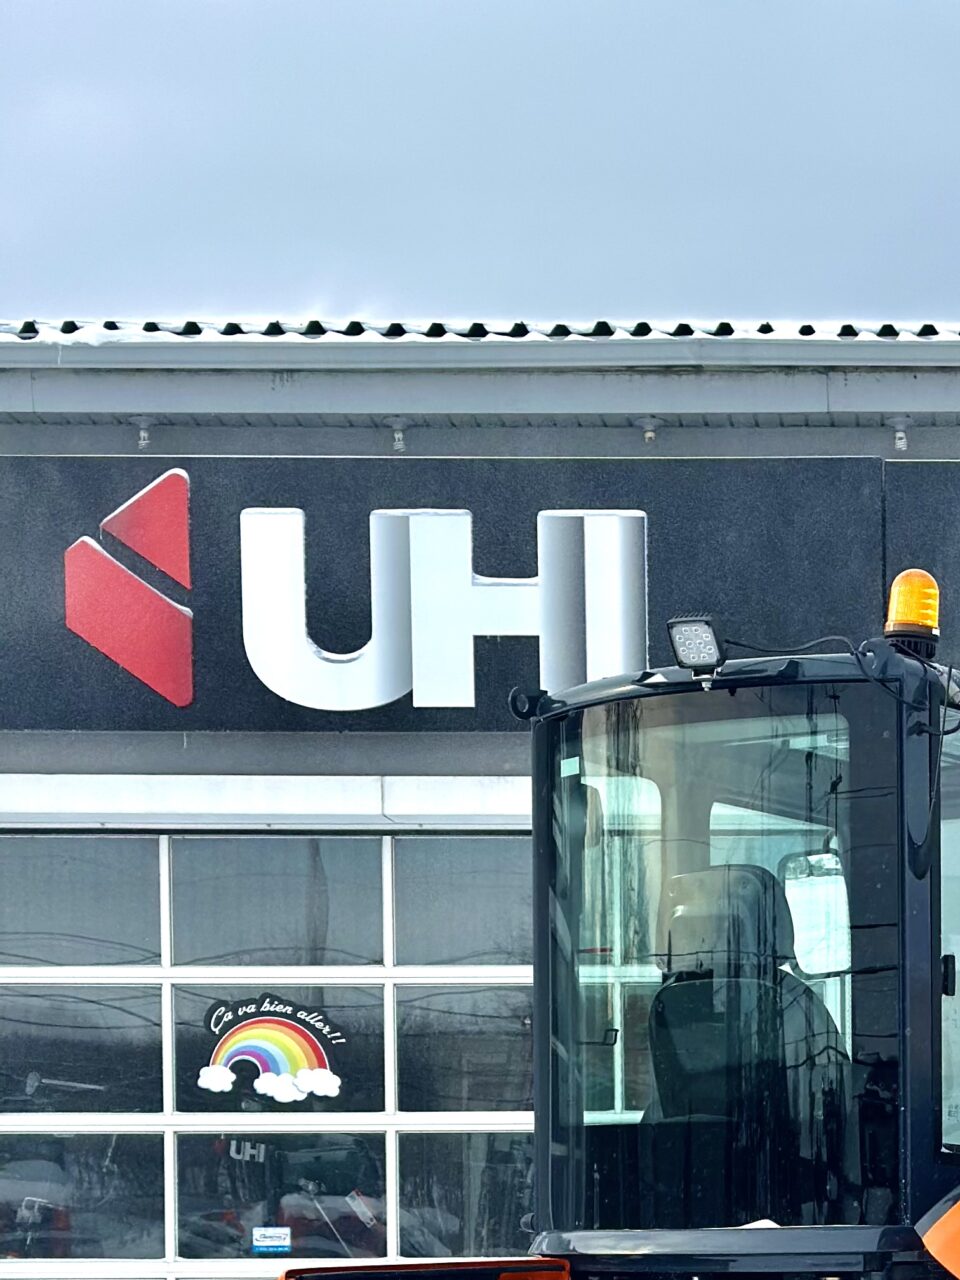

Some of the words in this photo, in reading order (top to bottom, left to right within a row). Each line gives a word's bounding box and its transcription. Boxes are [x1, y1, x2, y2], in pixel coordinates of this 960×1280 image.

[240, 507, 648, 711] UHI
[210, 1006, 234, 1035] Ça
[237, 1003, 257, 1016] va
[260, 998, 294, 1015] bien
[296, 1009, 347, 1045] aller!!
[229, 1139, 266, 1163] UHI
